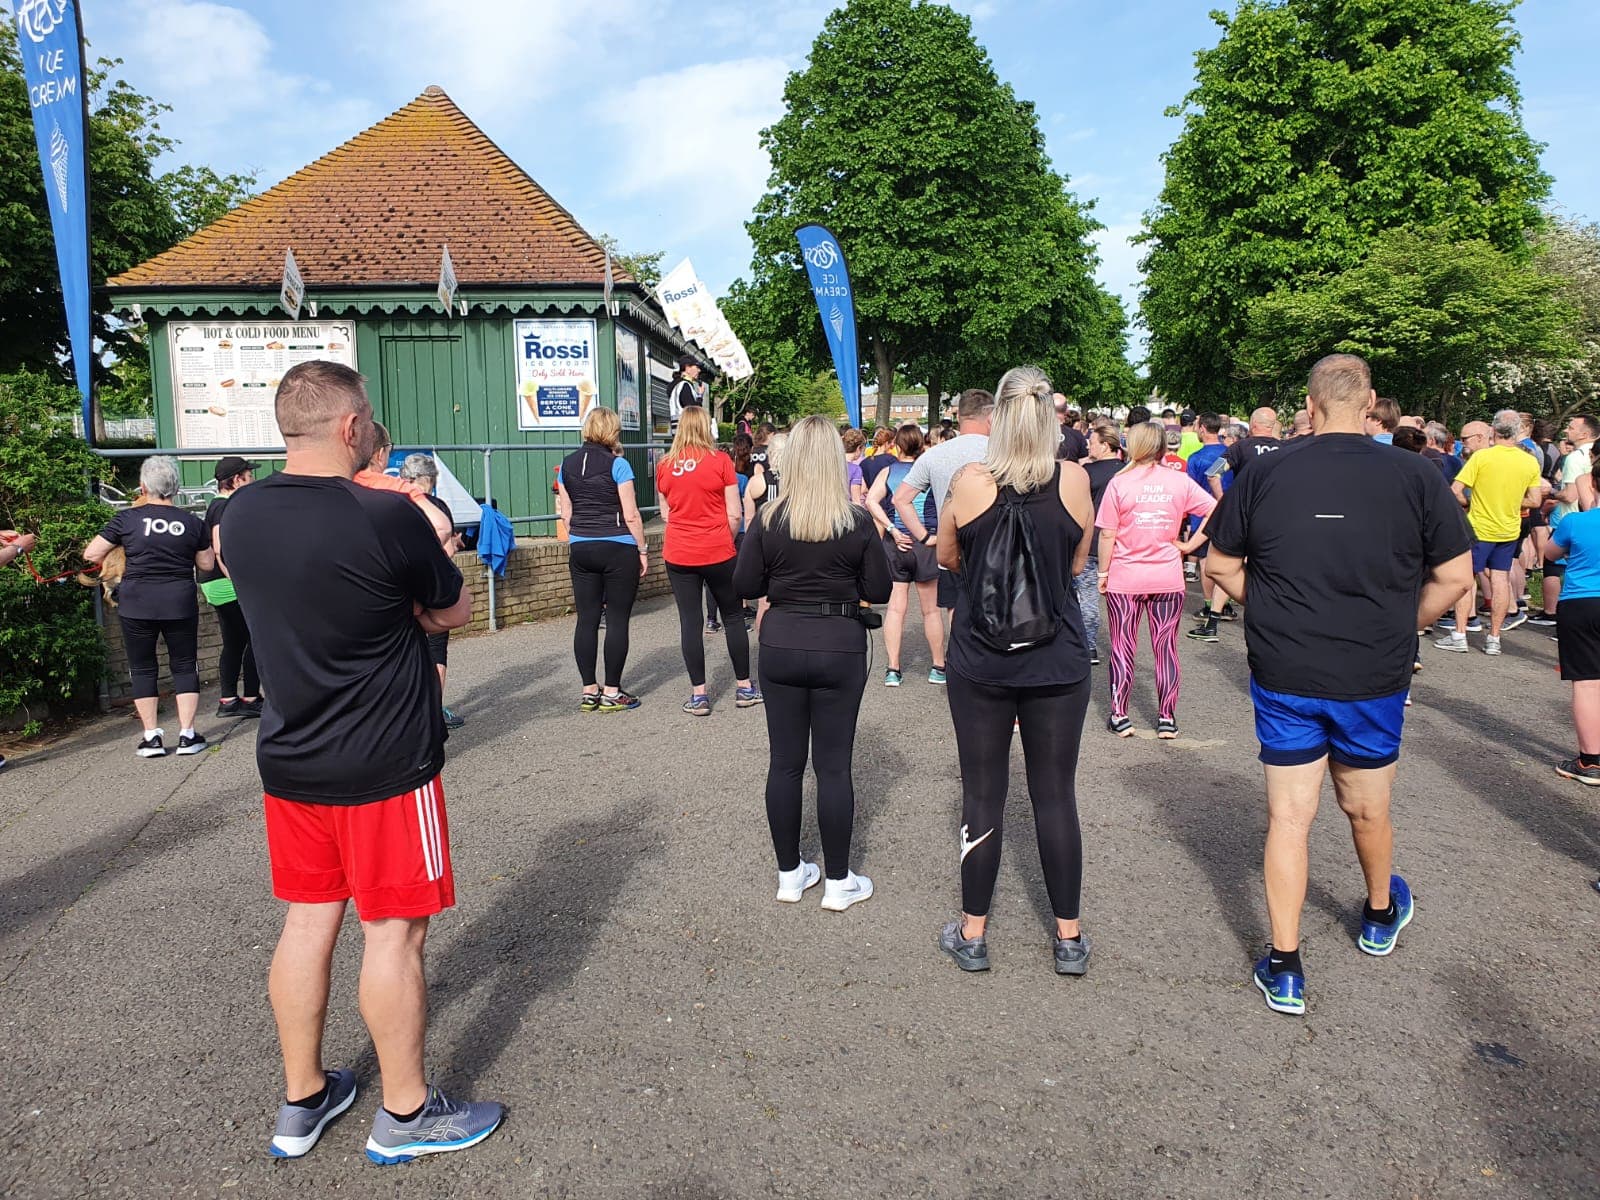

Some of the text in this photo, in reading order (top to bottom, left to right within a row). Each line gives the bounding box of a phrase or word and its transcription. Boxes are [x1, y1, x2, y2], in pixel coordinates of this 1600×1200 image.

[40, 49, 64, 75] ICE
[31, 74, 76, 107] CREAM
[663, 283, 698, 304] Rossi
[203, 326, 320, 338] HOT & COLD FOOD MENU
[525, 340, 589, 359] Rossi
[672, 458, 696, 476] 50
[1143, 484, 1163, 493] RUN
[1135, 494, 1173, 503] LEADER
[142, 517, 185, 536] 100
